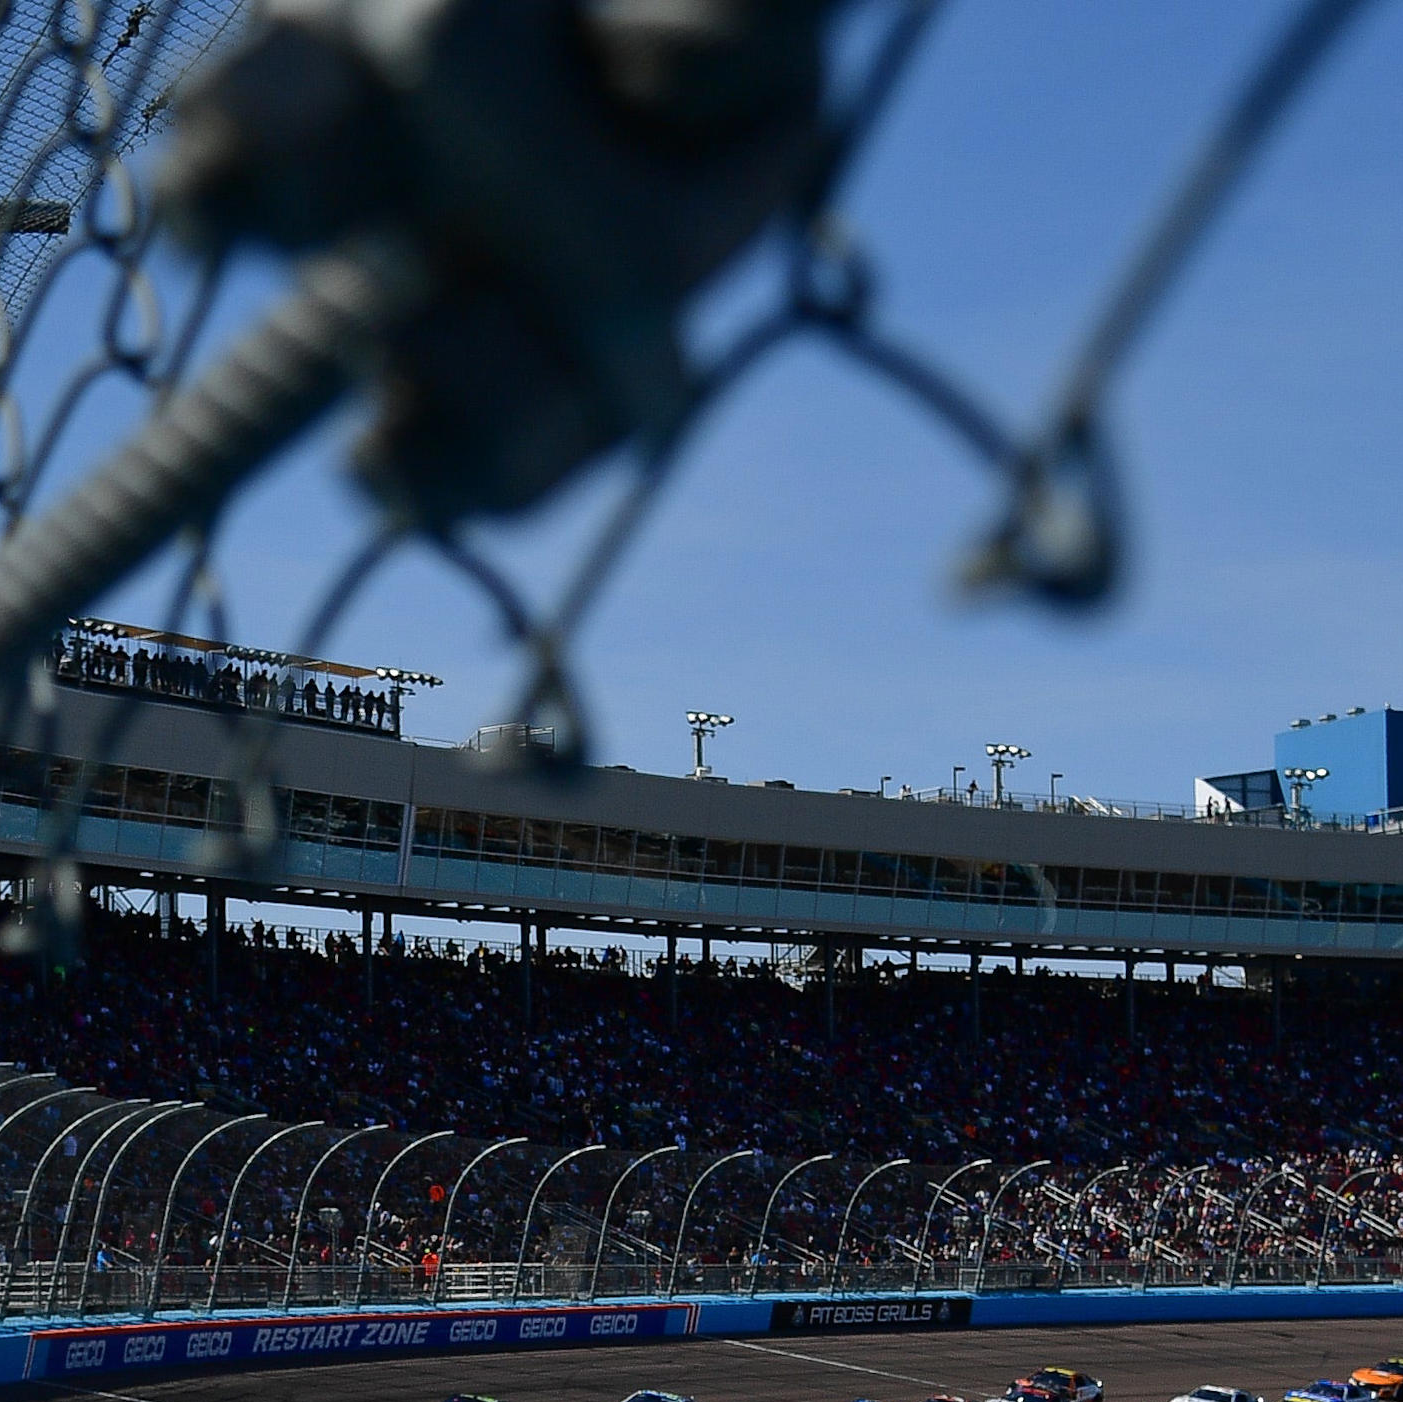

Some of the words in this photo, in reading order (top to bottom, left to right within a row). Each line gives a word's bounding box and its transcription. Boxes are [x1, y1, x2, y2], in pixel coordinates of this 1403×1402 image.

[589, 1314, 638, 1335] GEICO
[808, 1307, 832, 1324] PIT
[833, 1306, 875, 1324] BOSS
[877, 1304, 933, 1323] GRILLS
[253, 1324, 360, 1353] RESTART
[360, 1321, 431, 1346] ZONE
[449, 1319, 498, 1342] GEICO
[518, 1316, 566, 1338] GEICO
[65, 1339, 106, 1369] GEICO
[122, 1335, 166, 1363] GEICO
[185, 1331, 233, 1359] GEICO
